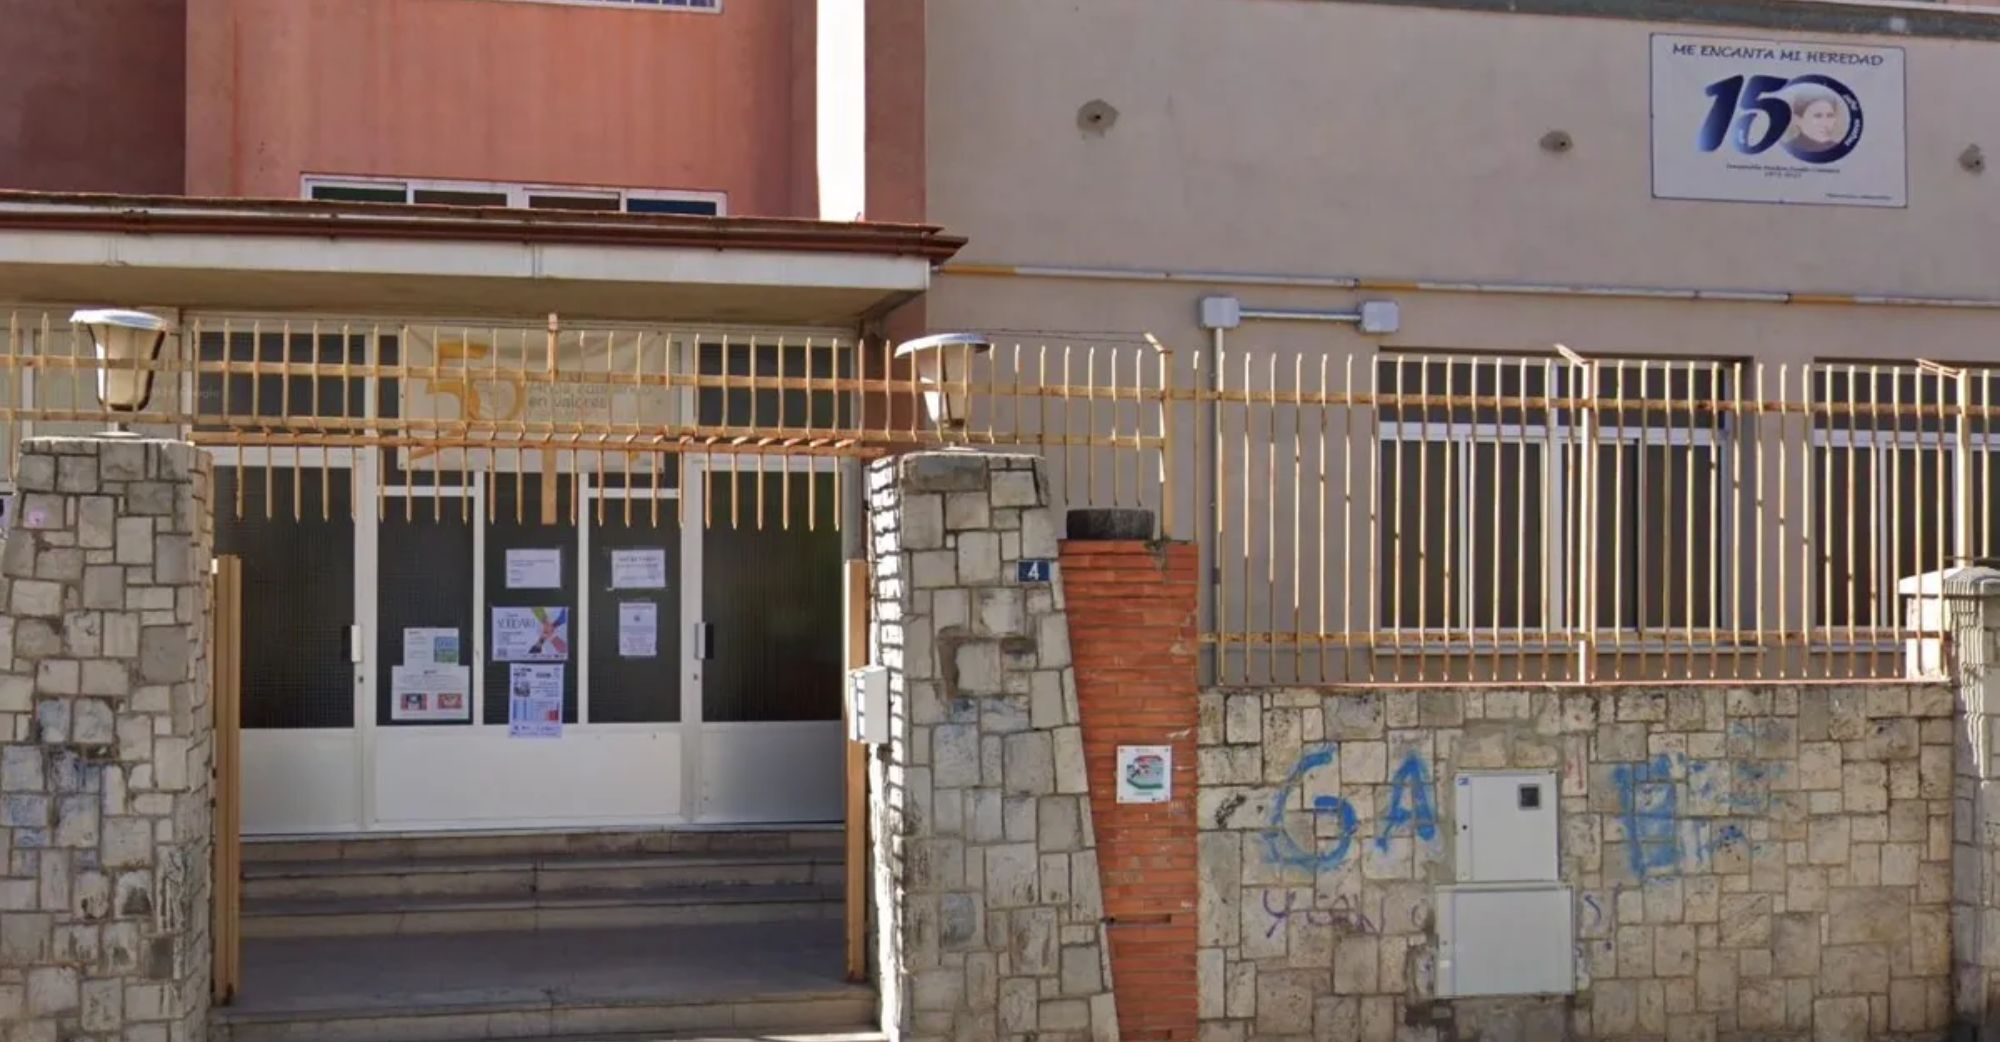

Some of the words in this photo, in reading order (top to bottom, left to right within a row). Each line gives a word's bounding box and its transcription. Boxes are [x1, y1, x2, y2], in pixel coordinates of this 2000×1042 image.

[1672, 43, 1697, 56] ME
[1700, 45, 1775, 60] ENCANTA
[1780, 50, 1801, 62] MI
[1806, 51, 1884, 66] HEREDAD
[1697, 74, 1863, 164] 150
[1028, 560, 1040, 580] 4
